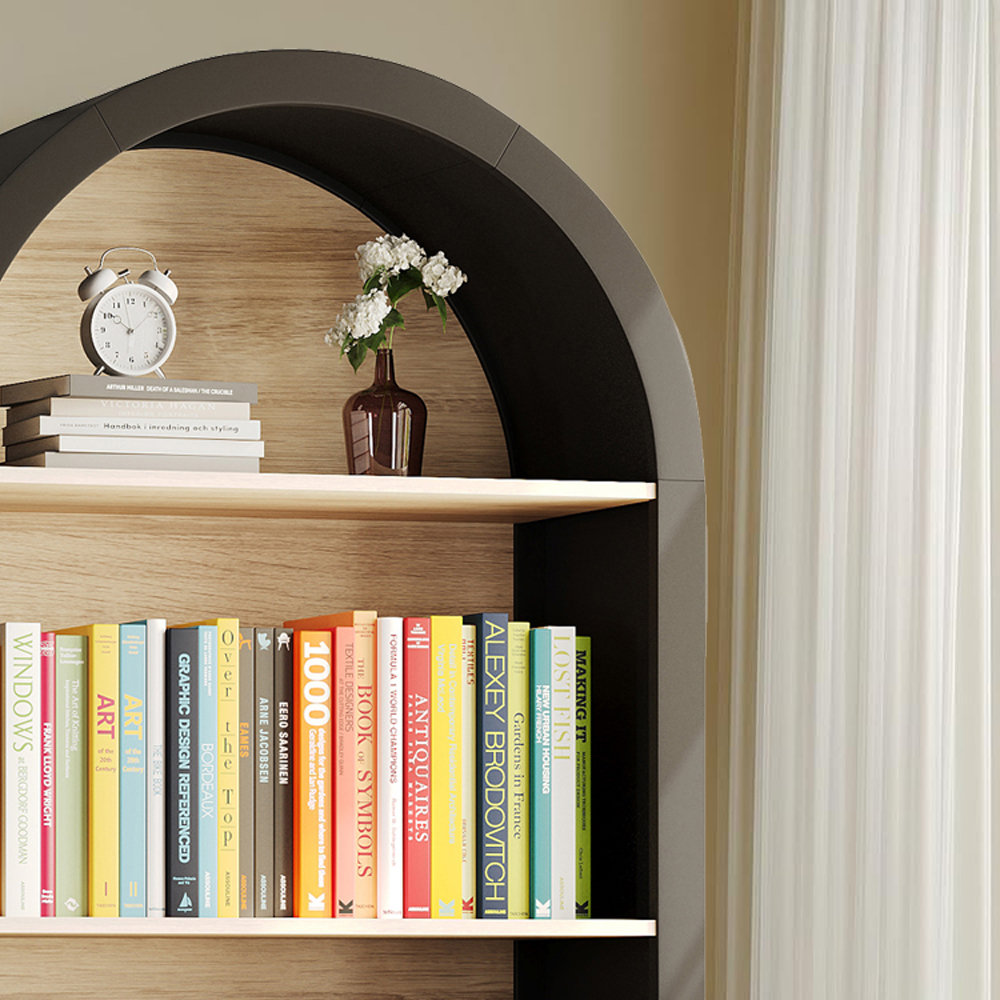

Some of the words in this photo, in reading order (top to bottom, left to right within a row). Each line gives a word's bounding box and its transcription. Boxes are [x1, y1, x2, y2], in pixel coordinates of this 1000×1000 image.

[149, 424, 190, 432] inredning
[345, 643, 354, 678] TEXTILE
[436, 644, 446, 678] Virginia
[448, 644, 457, 668] Detail
[467, 639, 475, 685] TEXTILES
[485, 620, 505, 723] ALEXEY
[554, 636, 571, 699] LOST
[12, 632, 33, 752] WINDOWS
[178, 654, 191, 715] GRAPHIC
[304, 641, 330, 726] 1000
[345, 681, 354, 732] DESIGNERS
[438, 679, 446, 713] McLeod
[576, 650, 586, 720] MAKING
[97, 694, 114, 739] ART
[124, 694, 143, 740] ART
[259, 698, 269, 726] ARNE
[279, 702, 288, 728] EERO
[358, 685, 373, 745] BOOK
[446, 680, 457, 741] Contemporary
[554, 706, 571, 760] FISH
[576, 725, 586, 743] IT
[43, 723, 52, 754] FRANK
[178, 719, 191, 768] DESIGN
[239, 722, 249, 758] EAMES
[259, 729, 269, 783] JACOBSEN
[279, 731, 288, 784] SAARINEN
[513, 712, 525, 771] Gardens
[17, 766, 27, 813] BERGDORF
[43, 756, 52, 787] LLOYD
[201, 744, 214, 818] BORDEAUX
[412, 694, 428, 842] ANTIQUAIRES
[448, 744, 457, 791] Residential
[513, 774, 525, 787] in
[43, 788, 52, 827] WRIGHT
[178, 773, 191, 863] REFERENCED
[358, 770, 373, 878] SYMBOLS
[448, 792, 457, 844] Architecture
[485, 731, 505, 900] BRODOVITCH
[513, 793, 525, 839] France
[17, 815, 27, 864] GOODMAN
